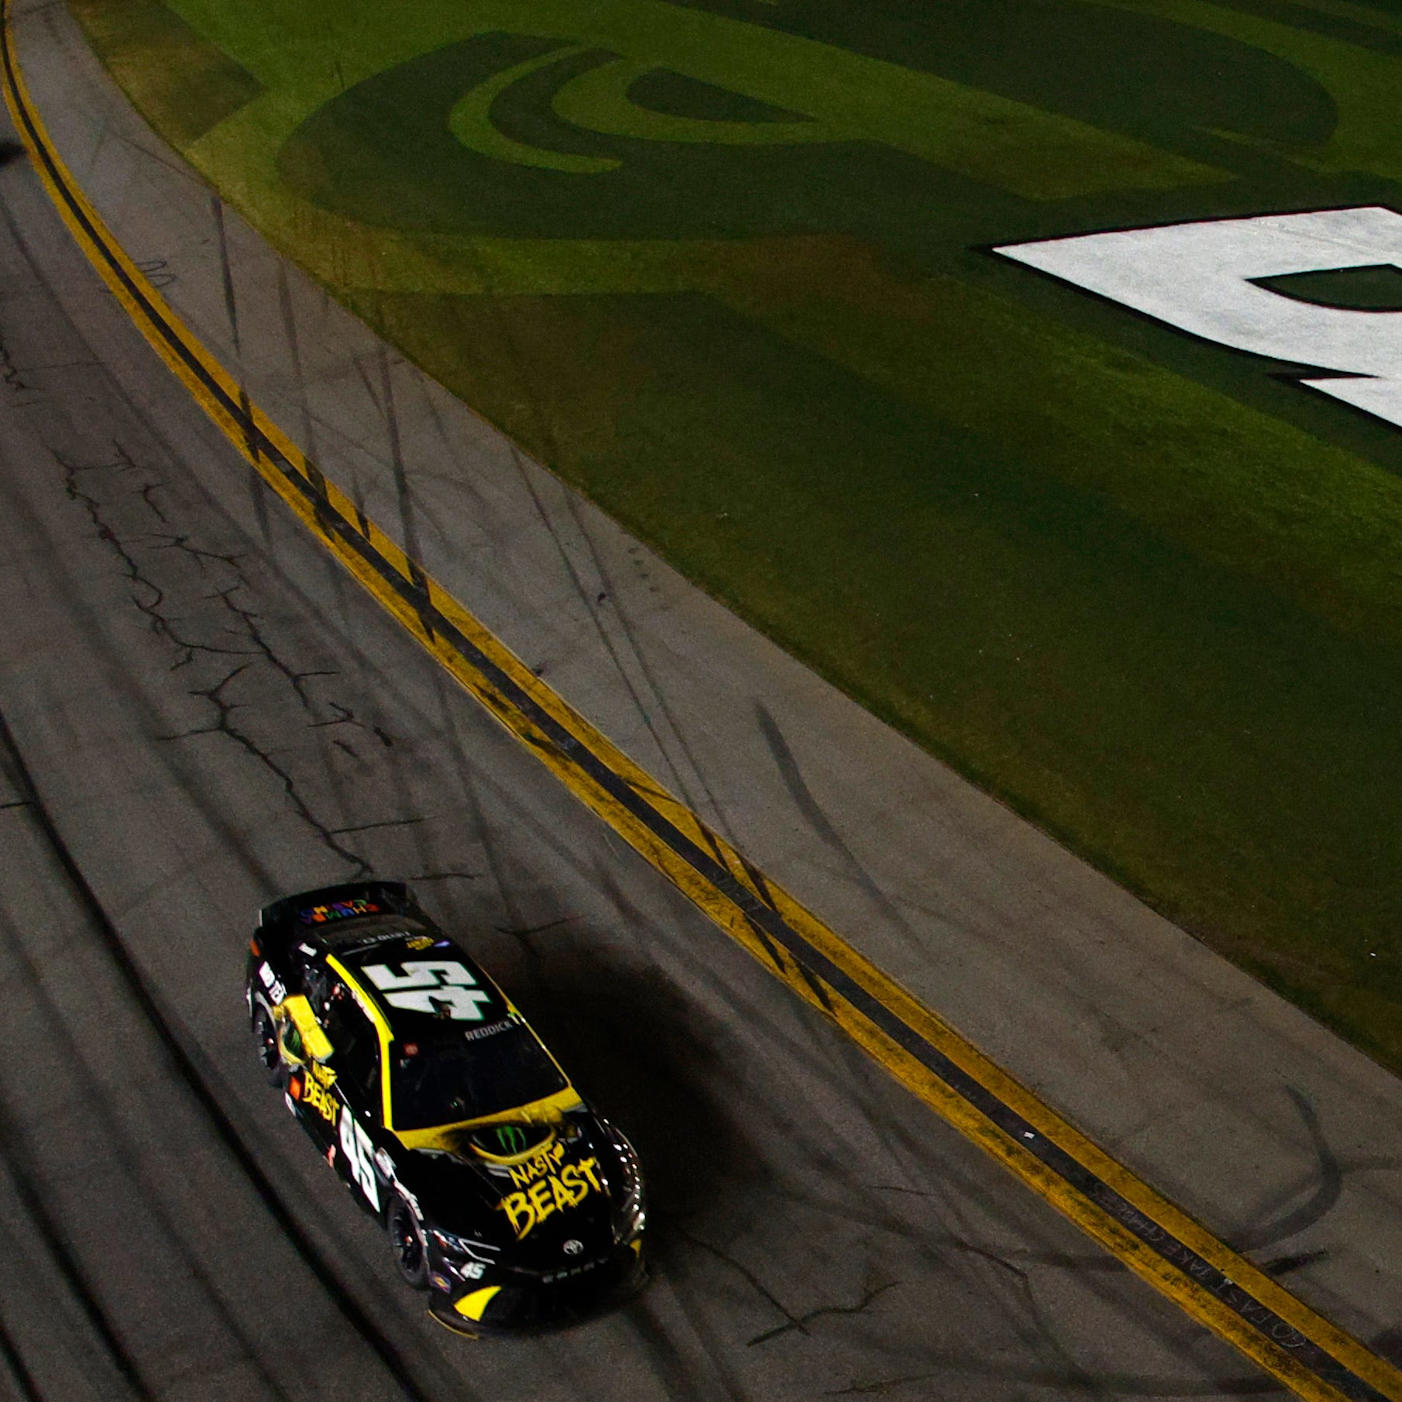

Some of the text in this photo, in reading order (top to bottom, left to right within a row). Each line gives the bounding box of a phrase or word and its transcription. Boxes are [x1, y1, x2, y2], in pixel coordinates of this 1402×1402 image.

[362, 959, 492, 1022] 45
[464, 1020, 514, 1042] REDDICK
[302, 1070, 341, 1127] BEAST
[338, 1103, 381, 1213] 45
[508, 1142, 565, 1189] NASTY
[501, 1155, 602, 1241] BEAST
